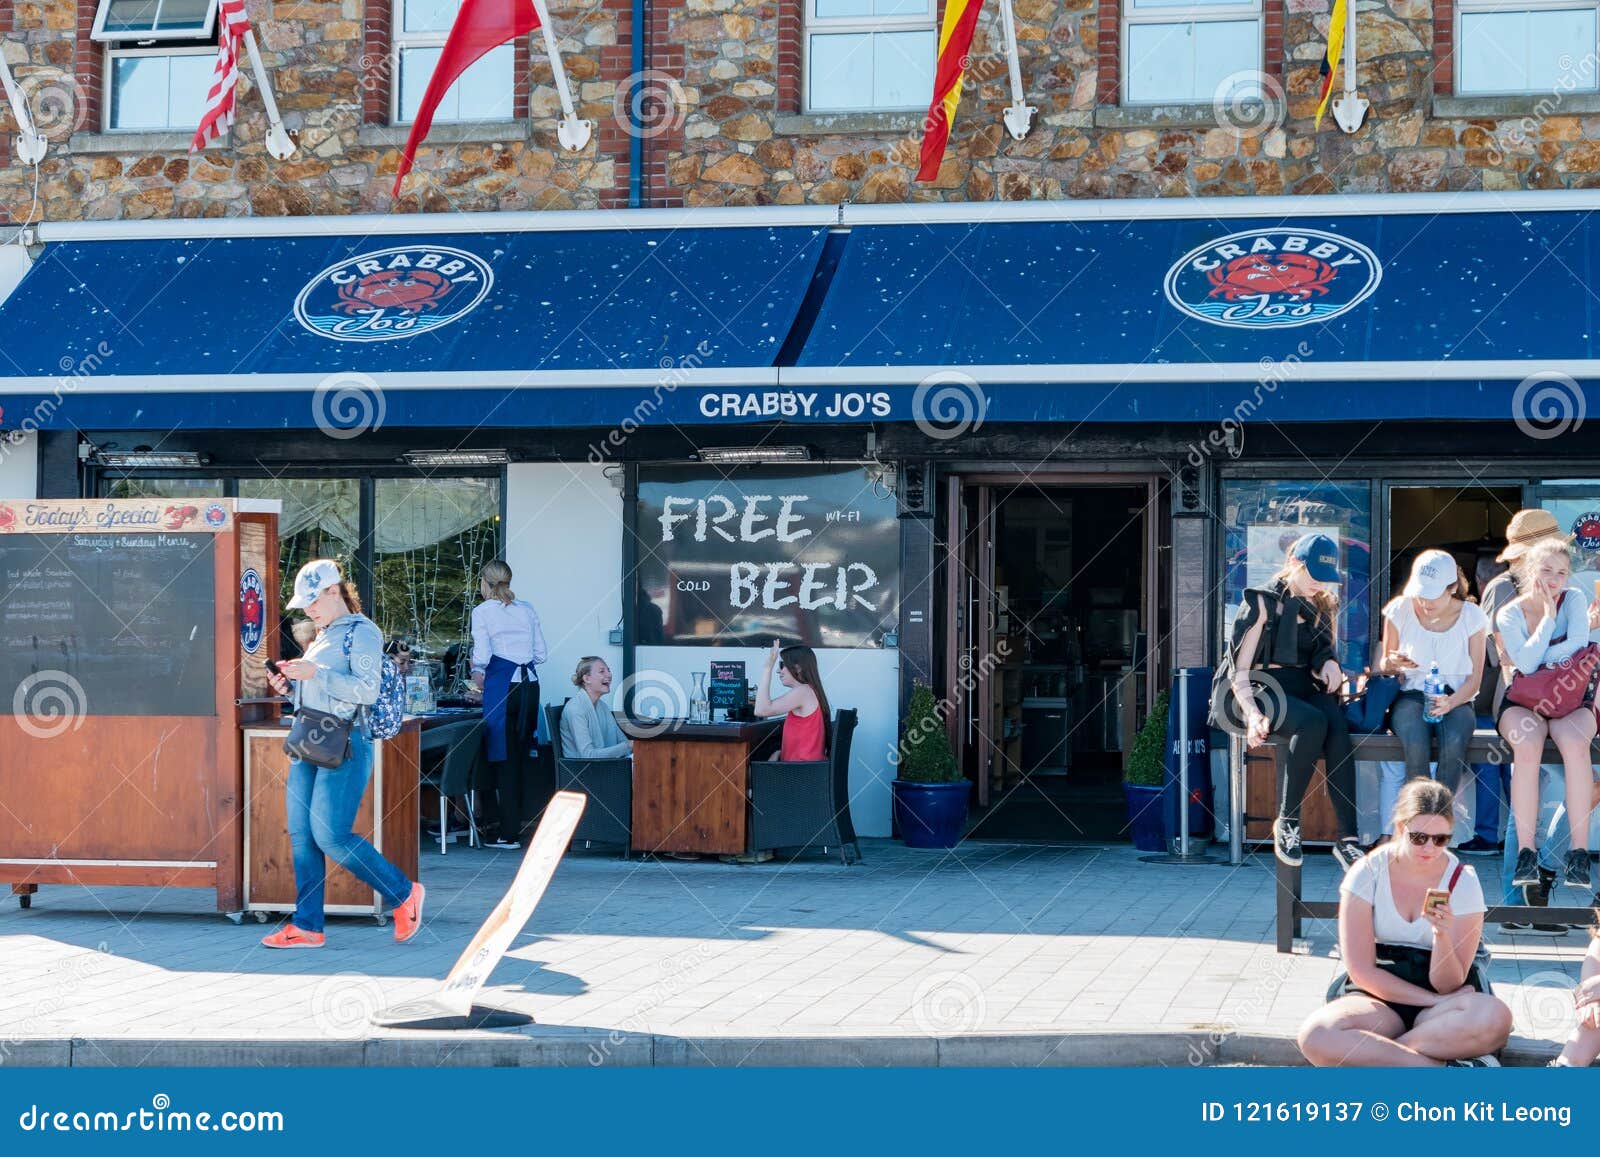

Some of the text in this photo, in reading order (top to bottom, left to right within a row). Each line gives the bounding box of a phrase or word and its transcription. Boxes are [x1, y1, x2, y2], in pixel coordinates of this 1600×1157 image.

[331, 253, 478, 285] CRABBY
[1192, 236, 1362, 272] CRABBY
[333, 308, 418, 334] Jo's
[1222, 294, 1313, 321] Jo's
[700, 391, 891, 417] CRABBY JO'S
[657, 494, 860, 543] FREE WI-FI
[676, 561, 880, 612] COLD BEER
